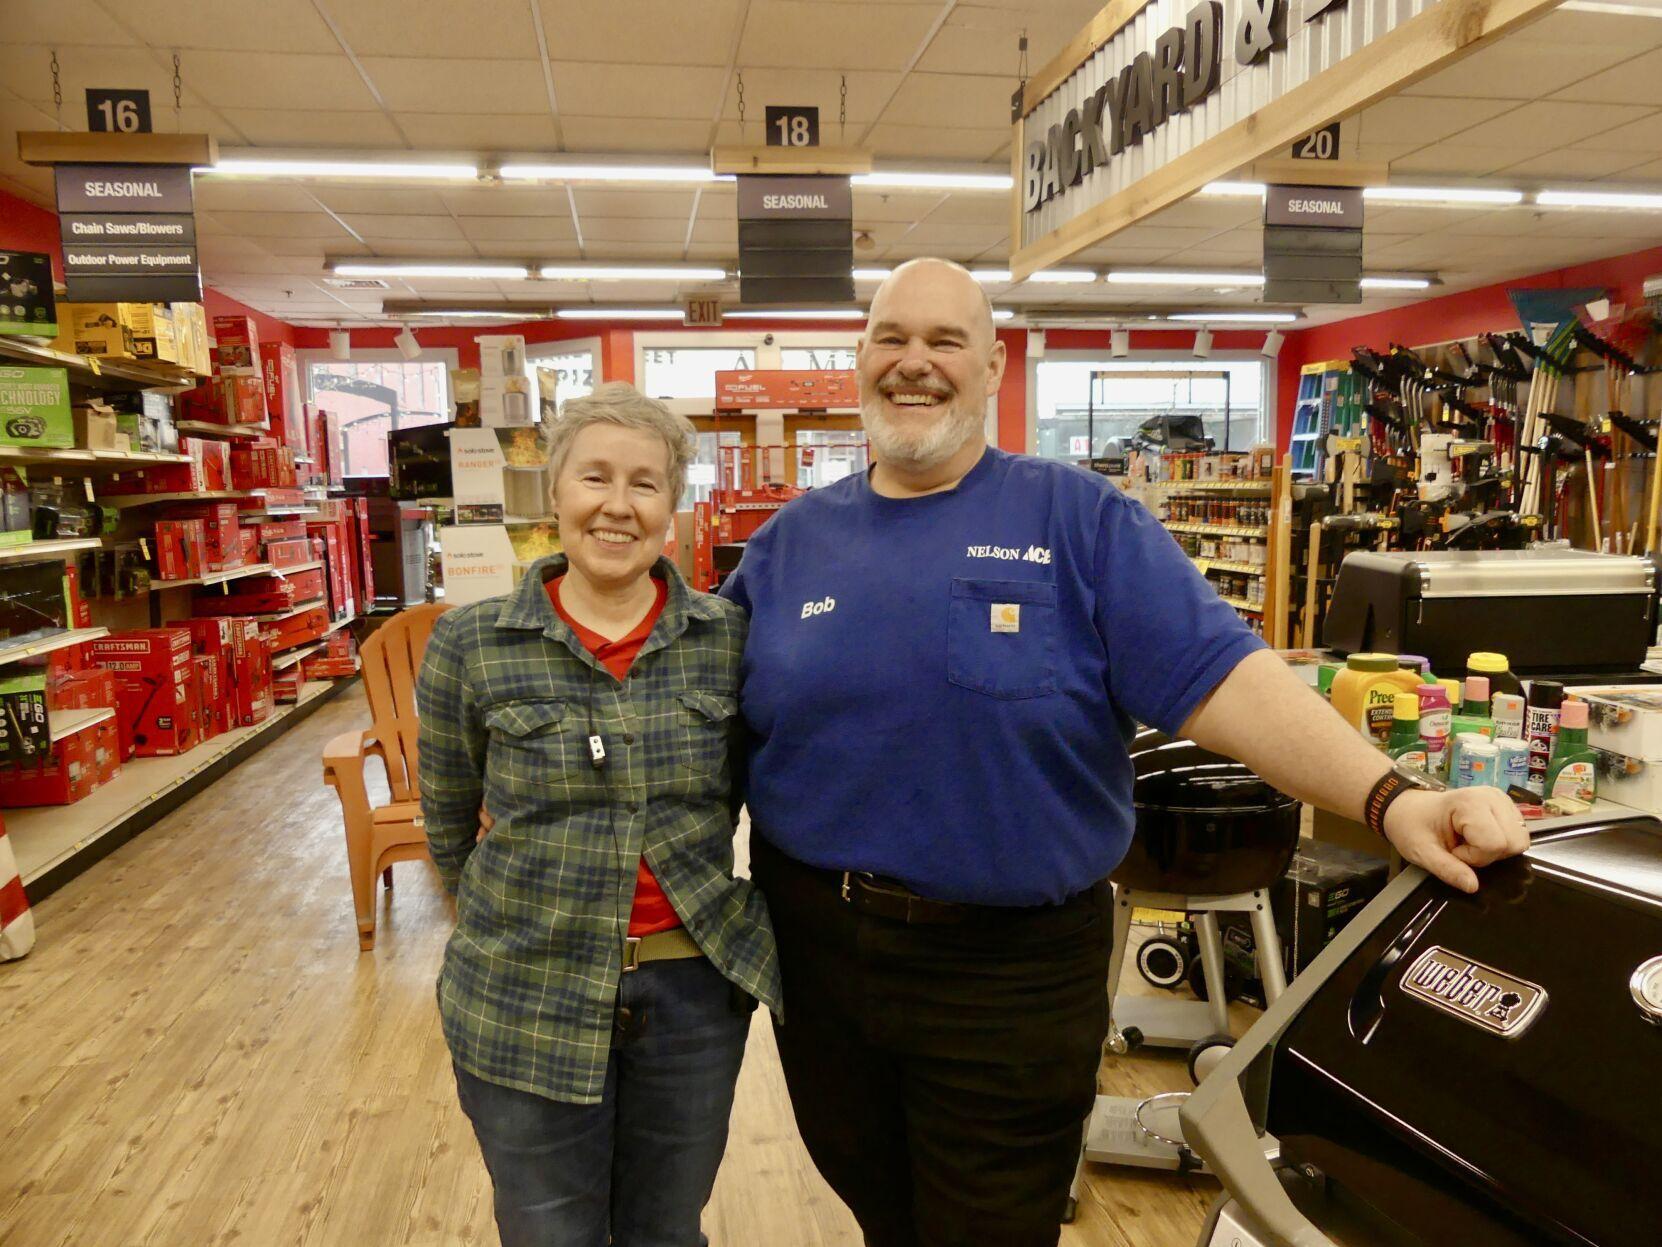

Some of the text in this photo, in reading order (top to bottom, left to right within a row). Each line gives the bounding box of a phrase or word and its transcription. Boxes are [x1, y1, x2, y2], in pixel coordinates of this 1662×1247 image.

[1025, 1, 1223, 213] BACKYARD
[97, 99, 140, 133] 16
[776, 115, 810, 147] 18
[1300, 130, 1333, 159] 20
[85, 182, 162, 197] SEASONAL
[763, 195, 828, 209] SEASONAL
[1288, 199, 1344, 214] SEASONAL
[72, 222, 183, 235] Chain Saws/Blowers
[68, 254, 191, 267] Outdoor Power Equipment
[689, 300, 719, 322] EXIT
[967, 544, 1051, 565] NELSON ACE
[447, 565, 496, 576] BONFIRE
[801, 596, 836, 619] Bob
[1369, 690, 1395, 704] Pree
[1532, 712, 1549, 723] TIRE
[1531, 722, 1552, 733] CARE
[1413, 959, 1501, 1011] weber
